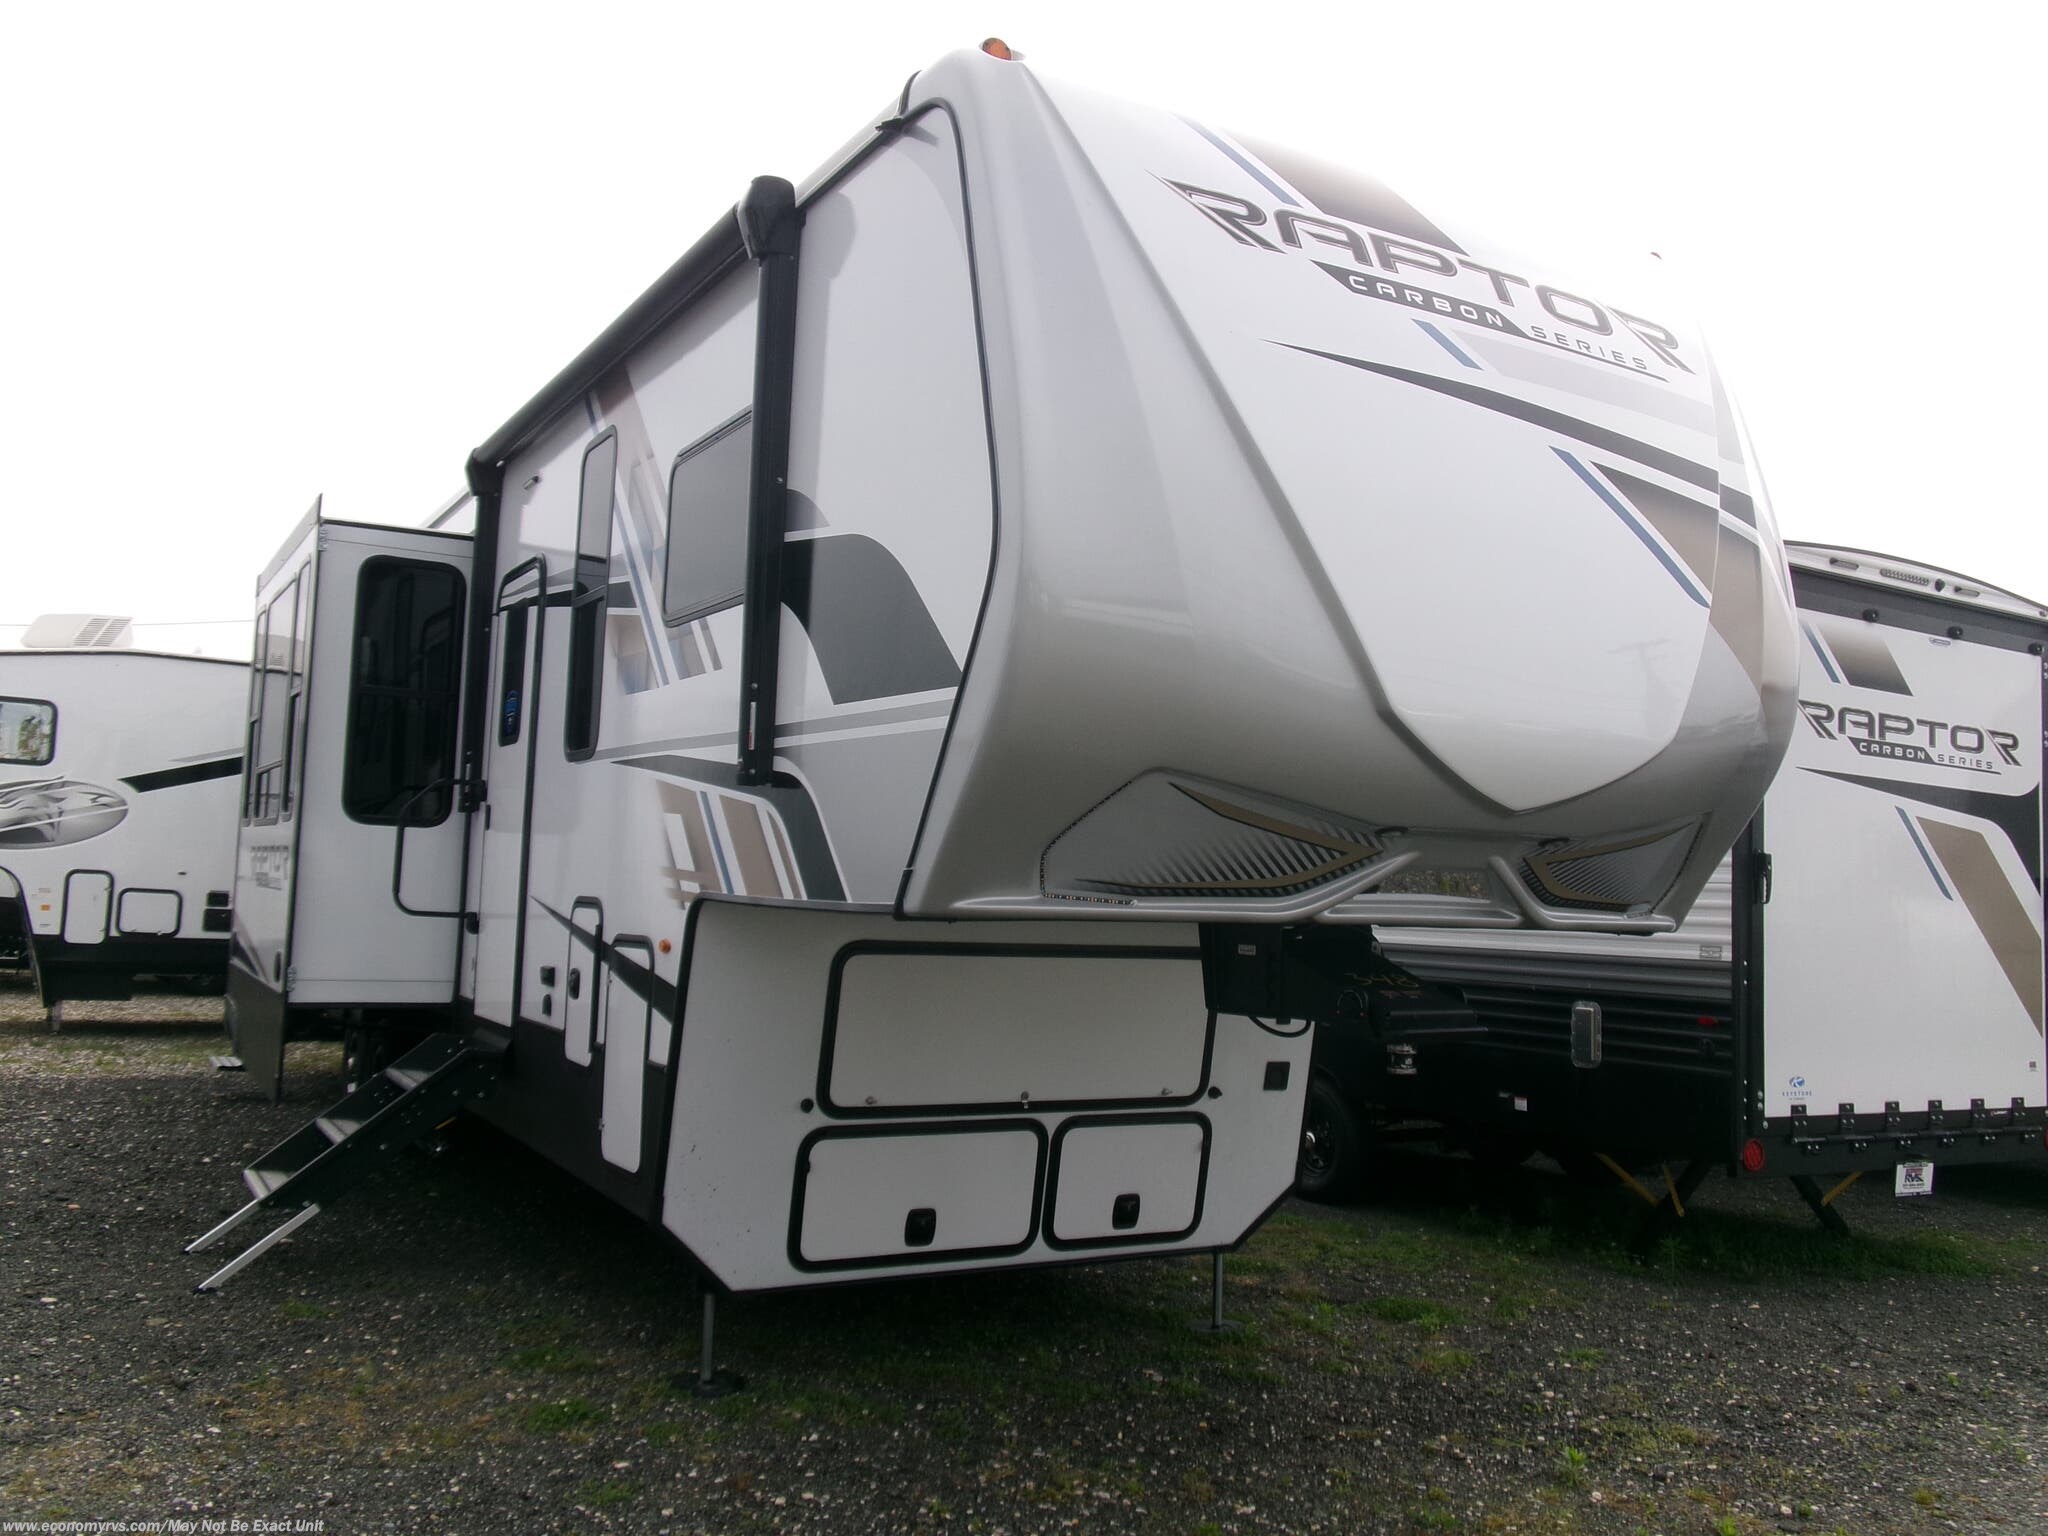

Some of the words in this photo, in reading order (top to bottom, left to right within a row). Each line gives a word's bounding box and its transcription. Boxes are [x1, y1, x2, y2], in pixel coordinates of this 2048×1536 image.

[1158, 176, 1697, 375] RAPTOR
[1347, 274, 1504, 328] CARBON
[1529, 324, 1649, 371] SERIES
[1797, 698, 2022, 767] RAPTOR
[1858, 741, 1927, 760] CARBON
[1936, 753, 1994, 770] SERIES
